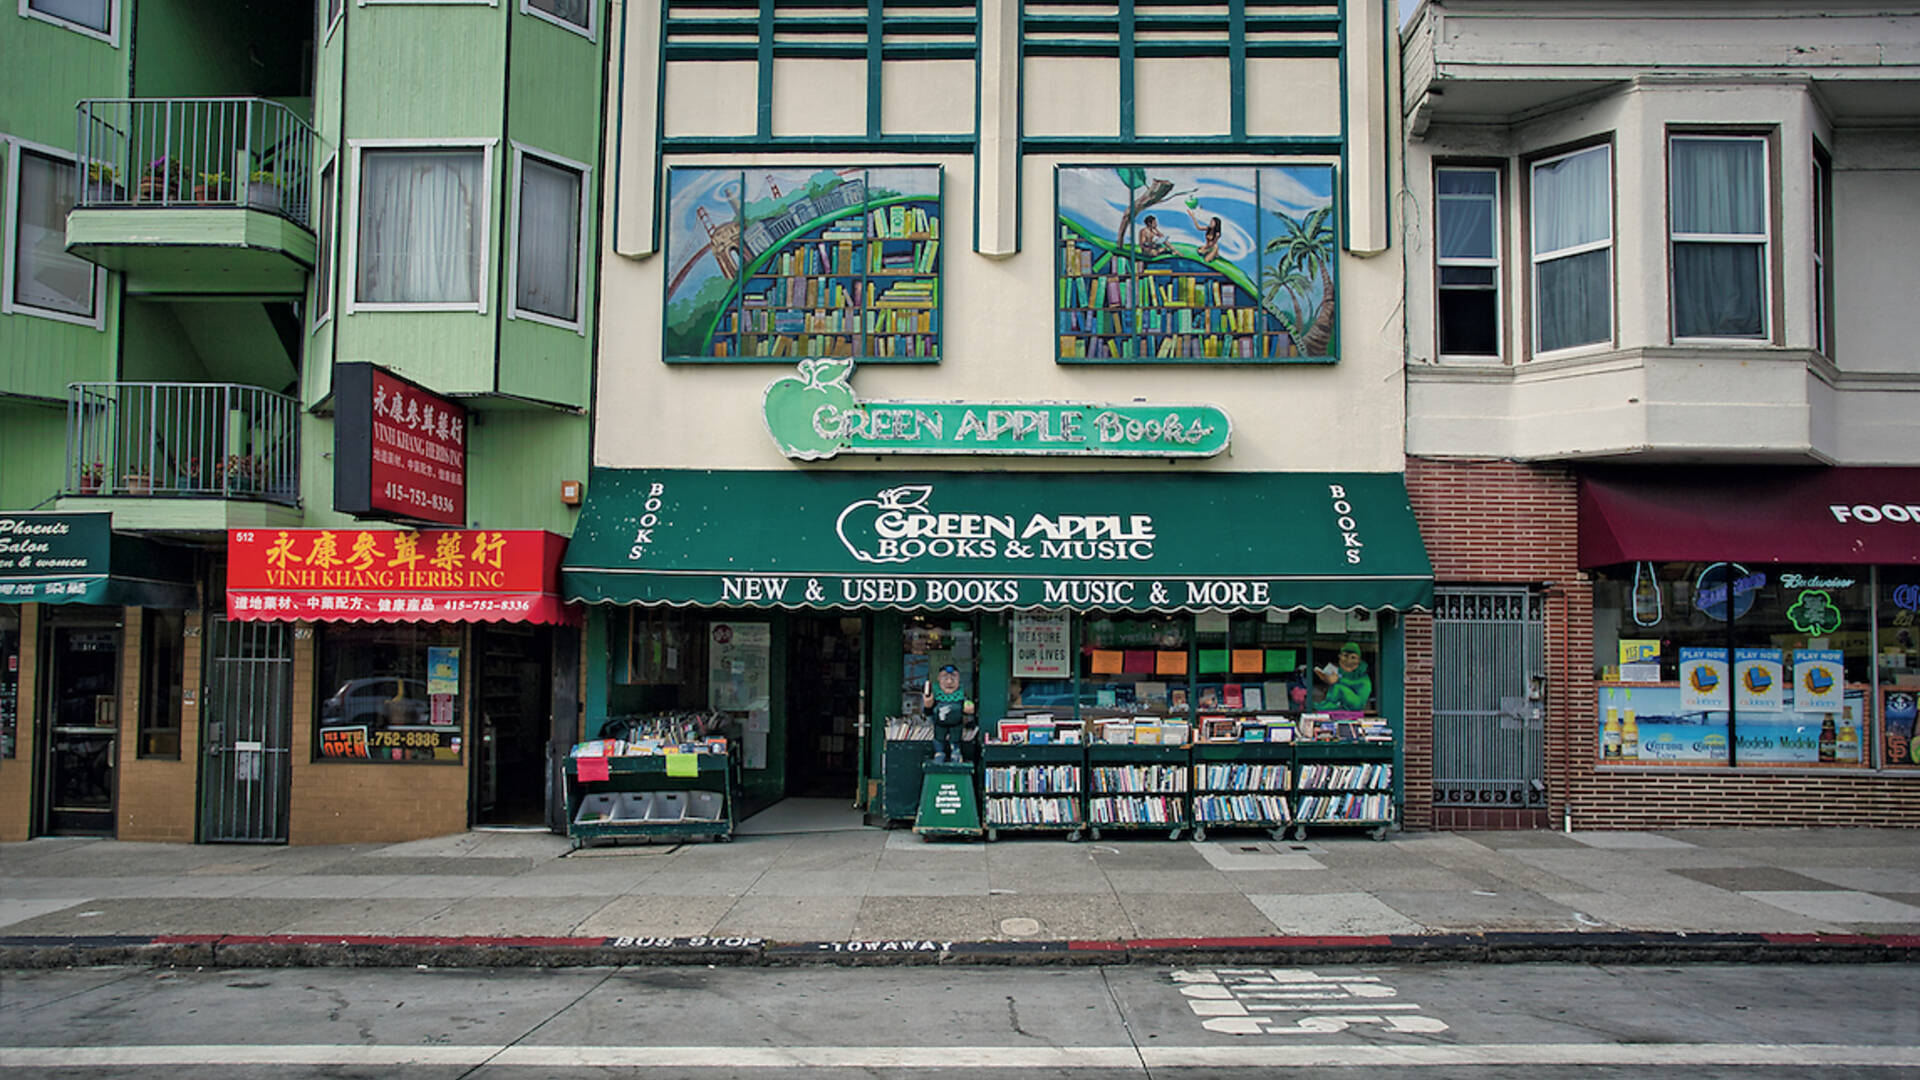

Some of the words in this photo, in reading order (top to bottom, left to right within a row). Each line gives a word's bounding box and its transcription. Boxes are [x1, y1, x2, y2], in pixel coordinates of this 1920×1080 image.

[813, 404, 943, 440] GREEN
[954, 410, 1087, 442] APPLE
[1094, 410, 1214, 445] Books
[374, 421, 397, 446] VINH
[397, 430, 426, 459] KHANG
[385, 482, 454, 513] 415-752-8336
[0, 519, 69, 534] Phoenix
[628, 483, 664, 560] BOOKS
[874, 511, 1015, 541] GREEN
[1021, 513, 1156, 541] APPLE
[1329, 484, 1362, 564] BOOKS
[236, 532, 253, 542] 512
[0, 538, 49, 553] Salon
[877, 539, 997, 559] BOOKS
[1004, 541, 1034, 559] &
[1040, 540, 1154, 560] MUSIC
[18, 555, 32, 568] &
[35, 558, 88, 567] women
[266, 570, 316, 586] VINH
[322, 570, 394, 587] KHANG
[400, 570, 463, 587] HERBS
[469, 571, 504, 587] INC
[721, 577, 789, 601] NEW
[804, 578, 826, 602] &
[842, 578, 917, 602] USED
[926, 579, 1018, 603] BOOKS
[1043, 581, 1134, 604] MUSIC
[1149, 581, 1170, 604] &
[1186, 582, 1271, 605] MORE
[443, 599, 530, 611] 415-752-8336
[1040, 649, 1066, 661] LIVES
[1683, 651, 1705, 660] PLAY
[1707, 652, 1726, 660] NOW
[1736, 652, 1758, 660] PLAY
[1761, 652, 1780, 660] NOW
[1797, 653, 1819, 661] PLAY
[1821, 653, 1841, 661] NOW
[323, 742, 366, 757] OPEN
[613, 937, 673, 947] BUS
[688, 937, 762, 947] STOP
